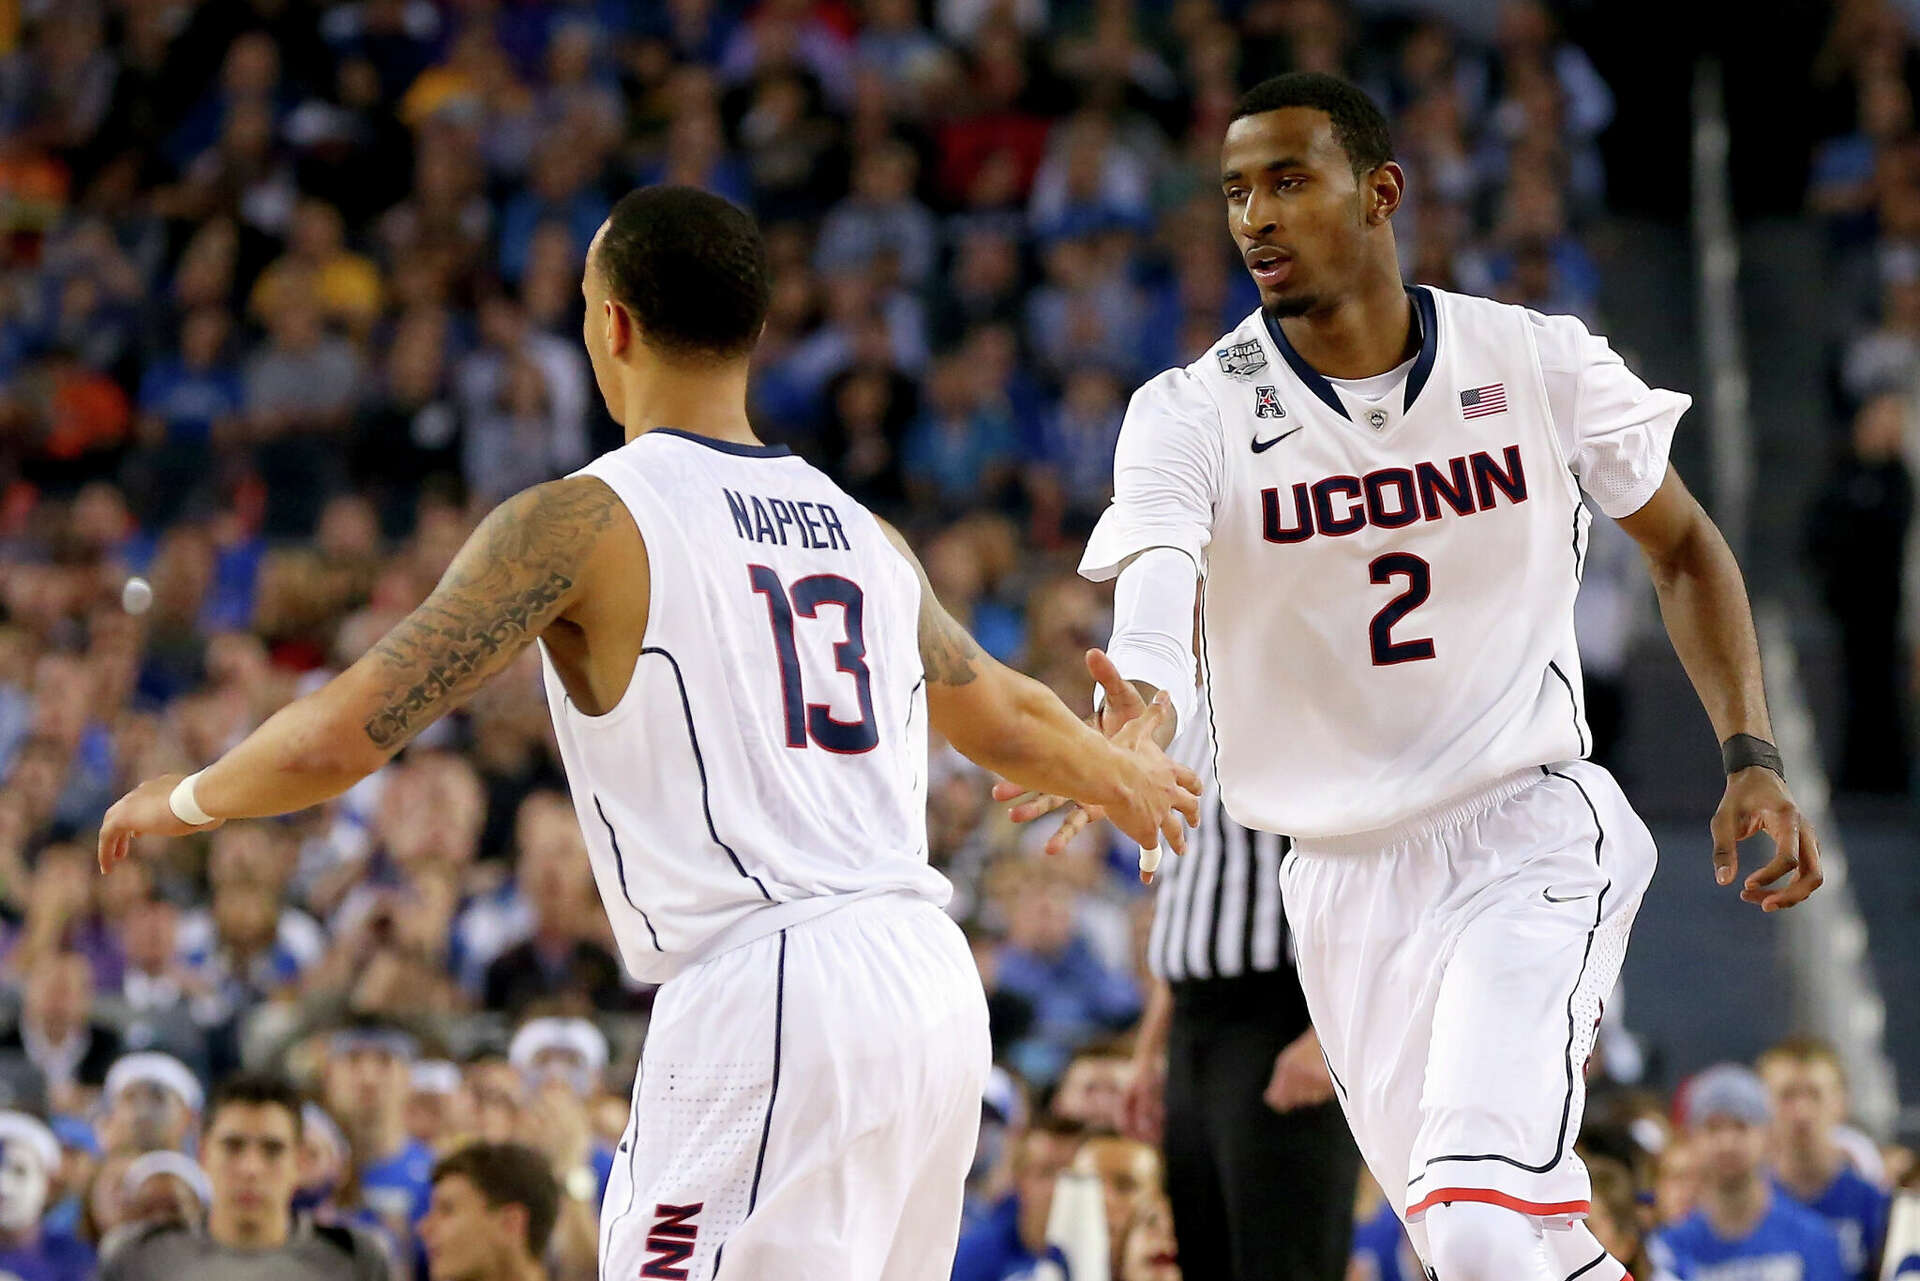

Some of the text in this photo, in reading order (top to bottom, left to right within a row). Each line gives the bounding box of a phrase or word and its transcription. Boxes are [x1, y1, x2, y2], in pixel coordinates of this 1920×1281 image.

[722, 487, 851, 551] NAPIER
[1261, 445, 1528, 544] UCONN
[746, 563, 880, 755] 13
[1368, 552, 1436, 666] 2
